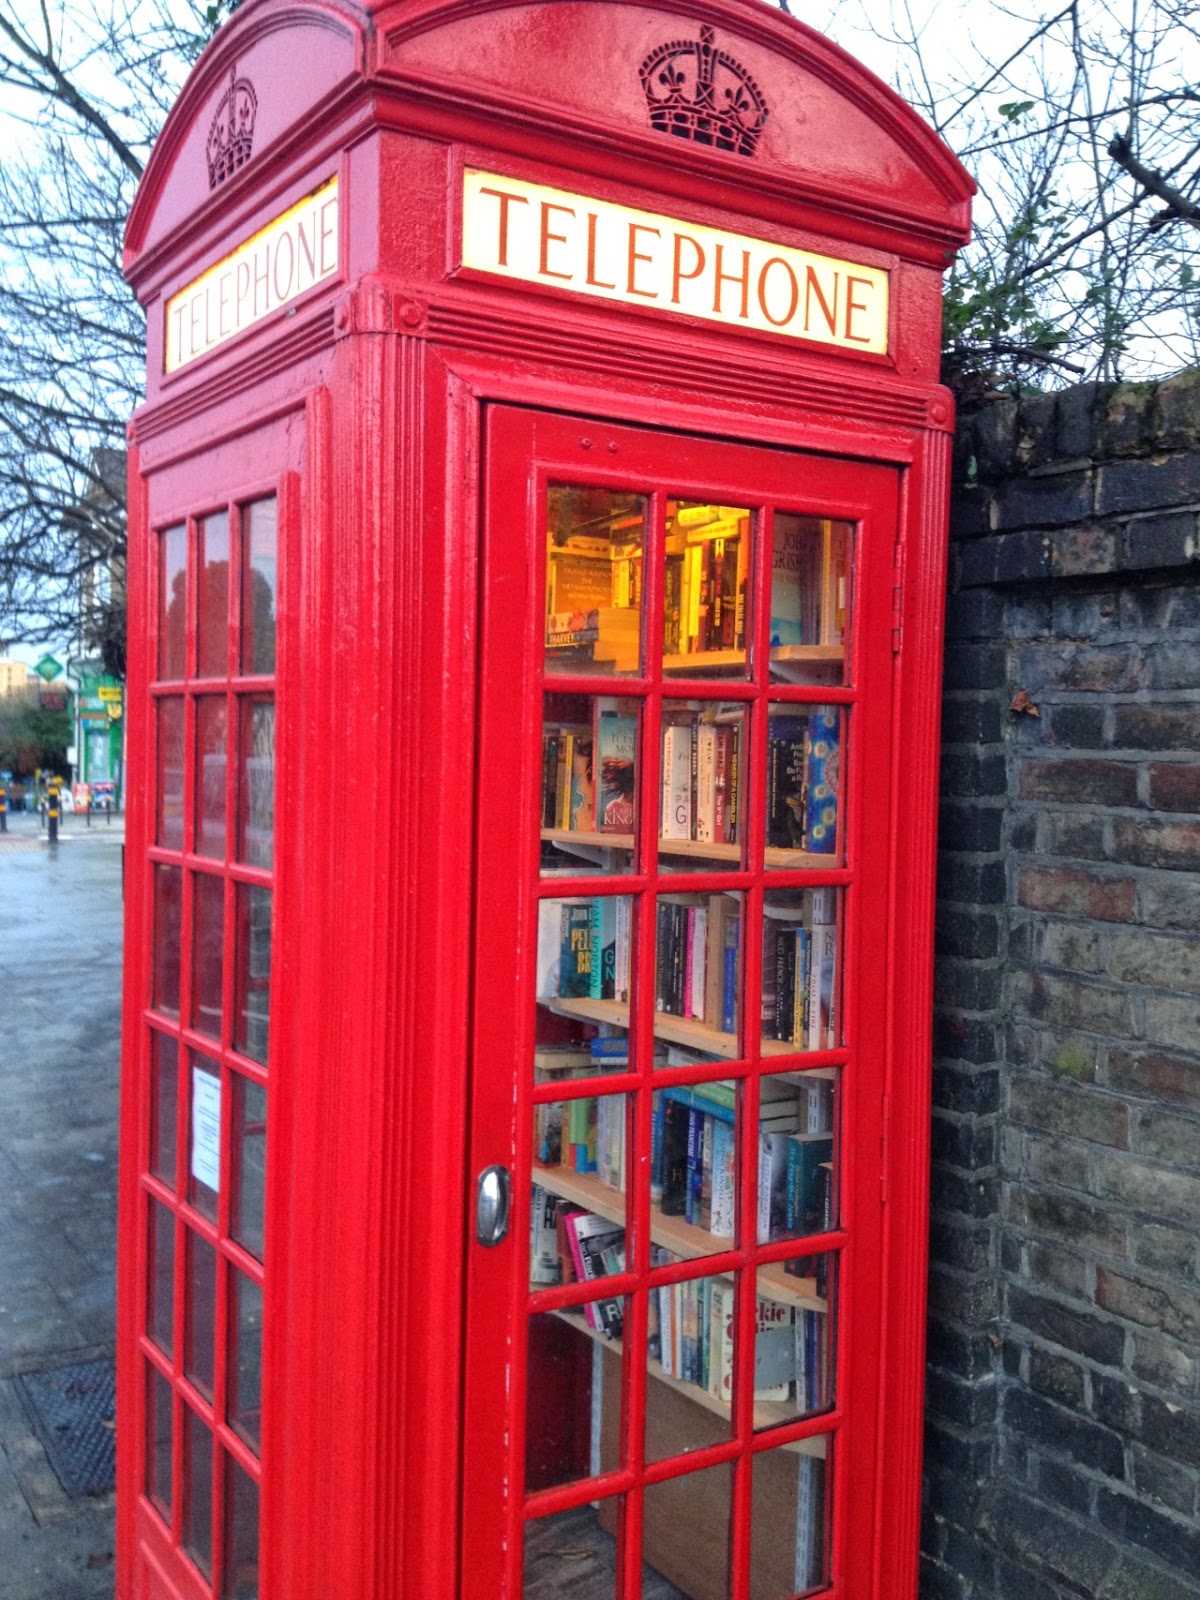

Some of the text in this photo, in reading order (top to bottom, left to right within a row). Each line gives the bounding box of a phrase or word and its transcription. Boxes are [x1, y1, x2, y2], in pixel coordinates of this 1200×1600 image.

[173, 196, 338, 364] TELEPHONE
[480, 186, 875, 344] TELEPHONE
[603, 811, 633, 825] KING
[591, 935, 600, 988] NORTON
